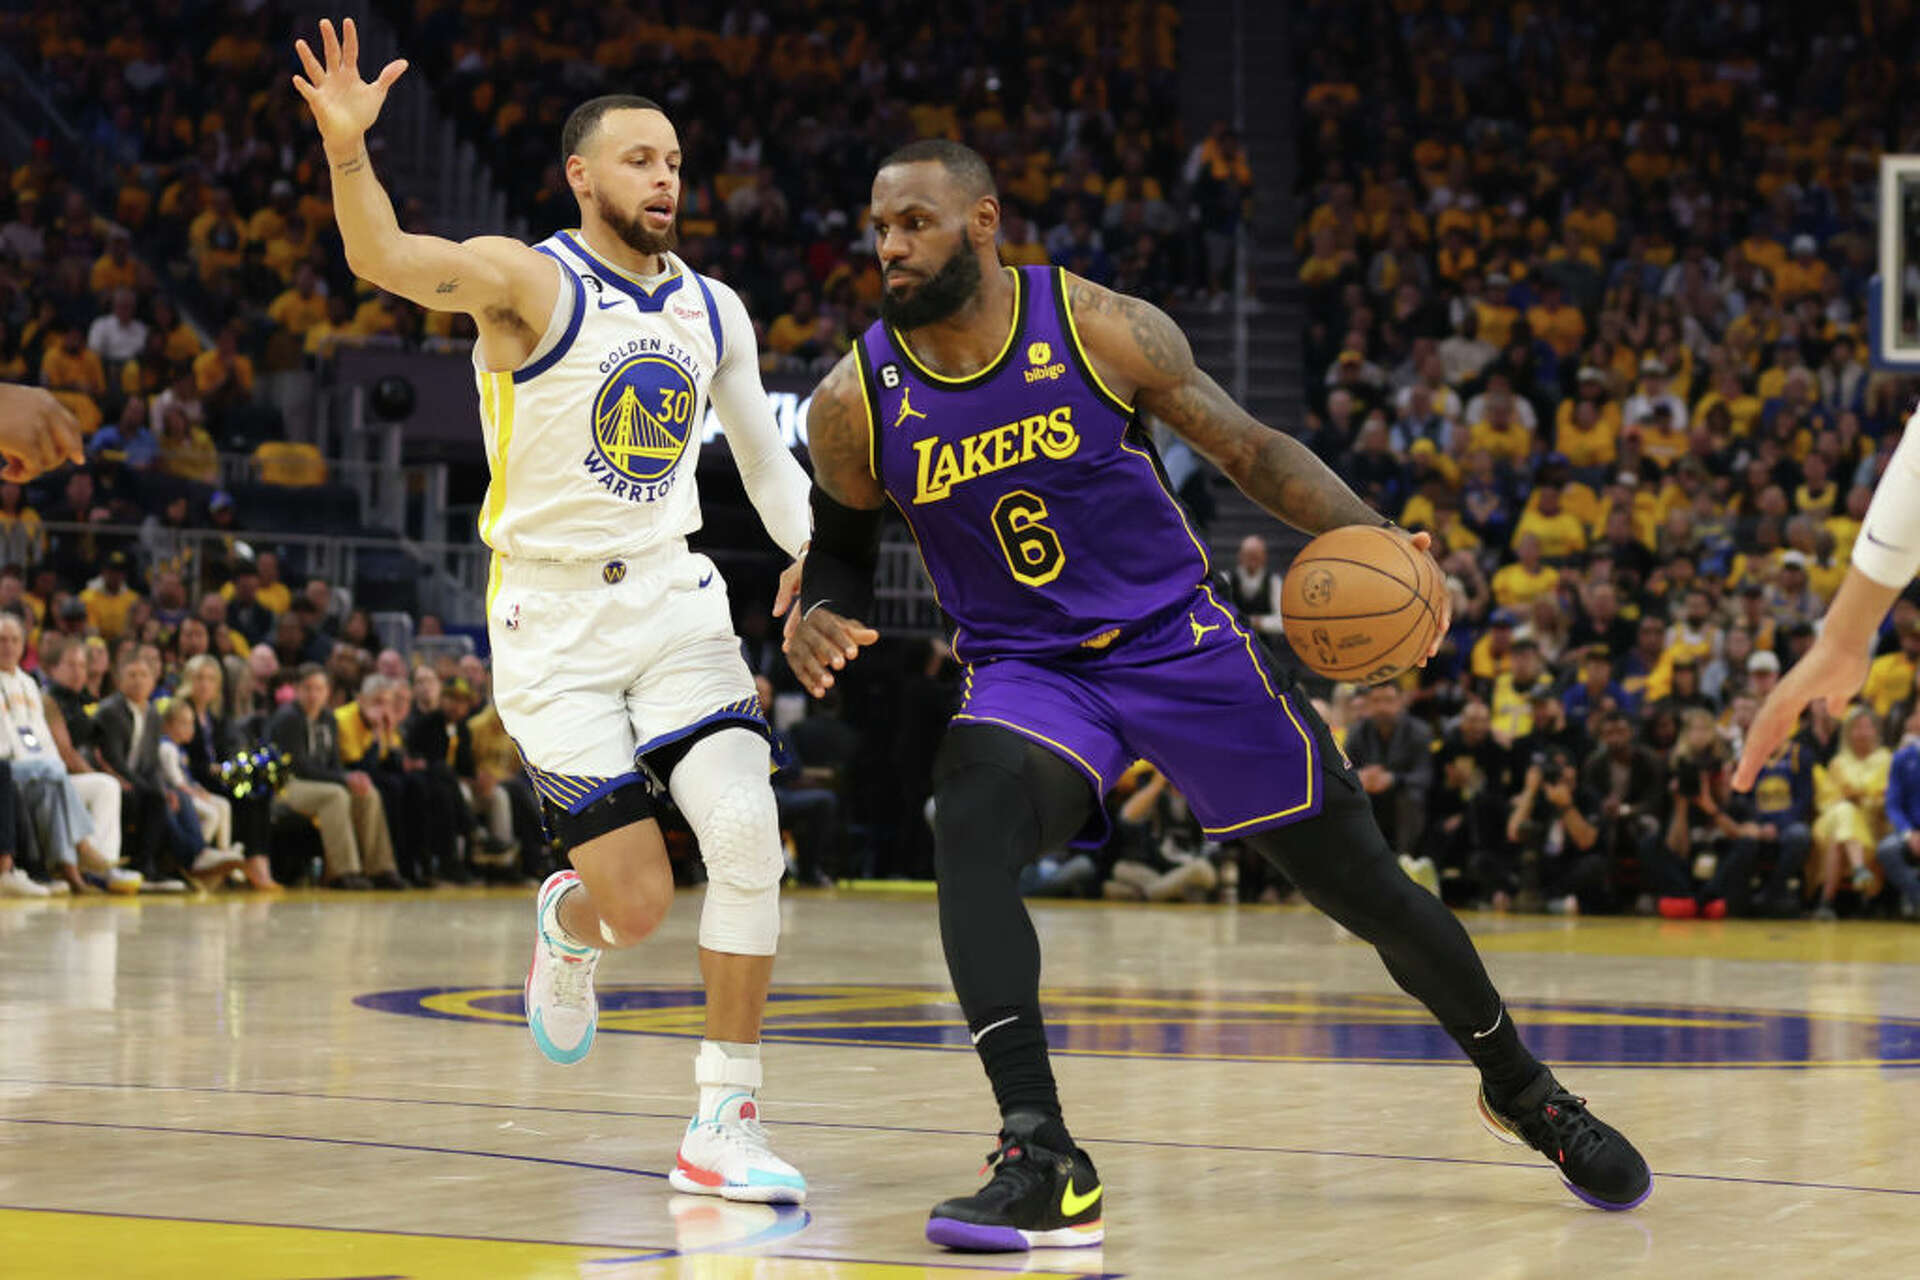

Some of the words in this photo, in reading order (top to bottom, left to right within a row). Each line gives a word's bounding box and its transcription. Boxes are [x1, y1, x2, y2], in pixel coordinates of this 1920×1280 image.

[599, 338, 661, 374] GOLDEN
[1023, 363, 1066, 384] bibigo
[882, 364, 899, 388] 6
[656, 387, 691, 424] 30
[912, 405, 1081, 505] LAKERS
[990, 489, 1066, 587] 6
